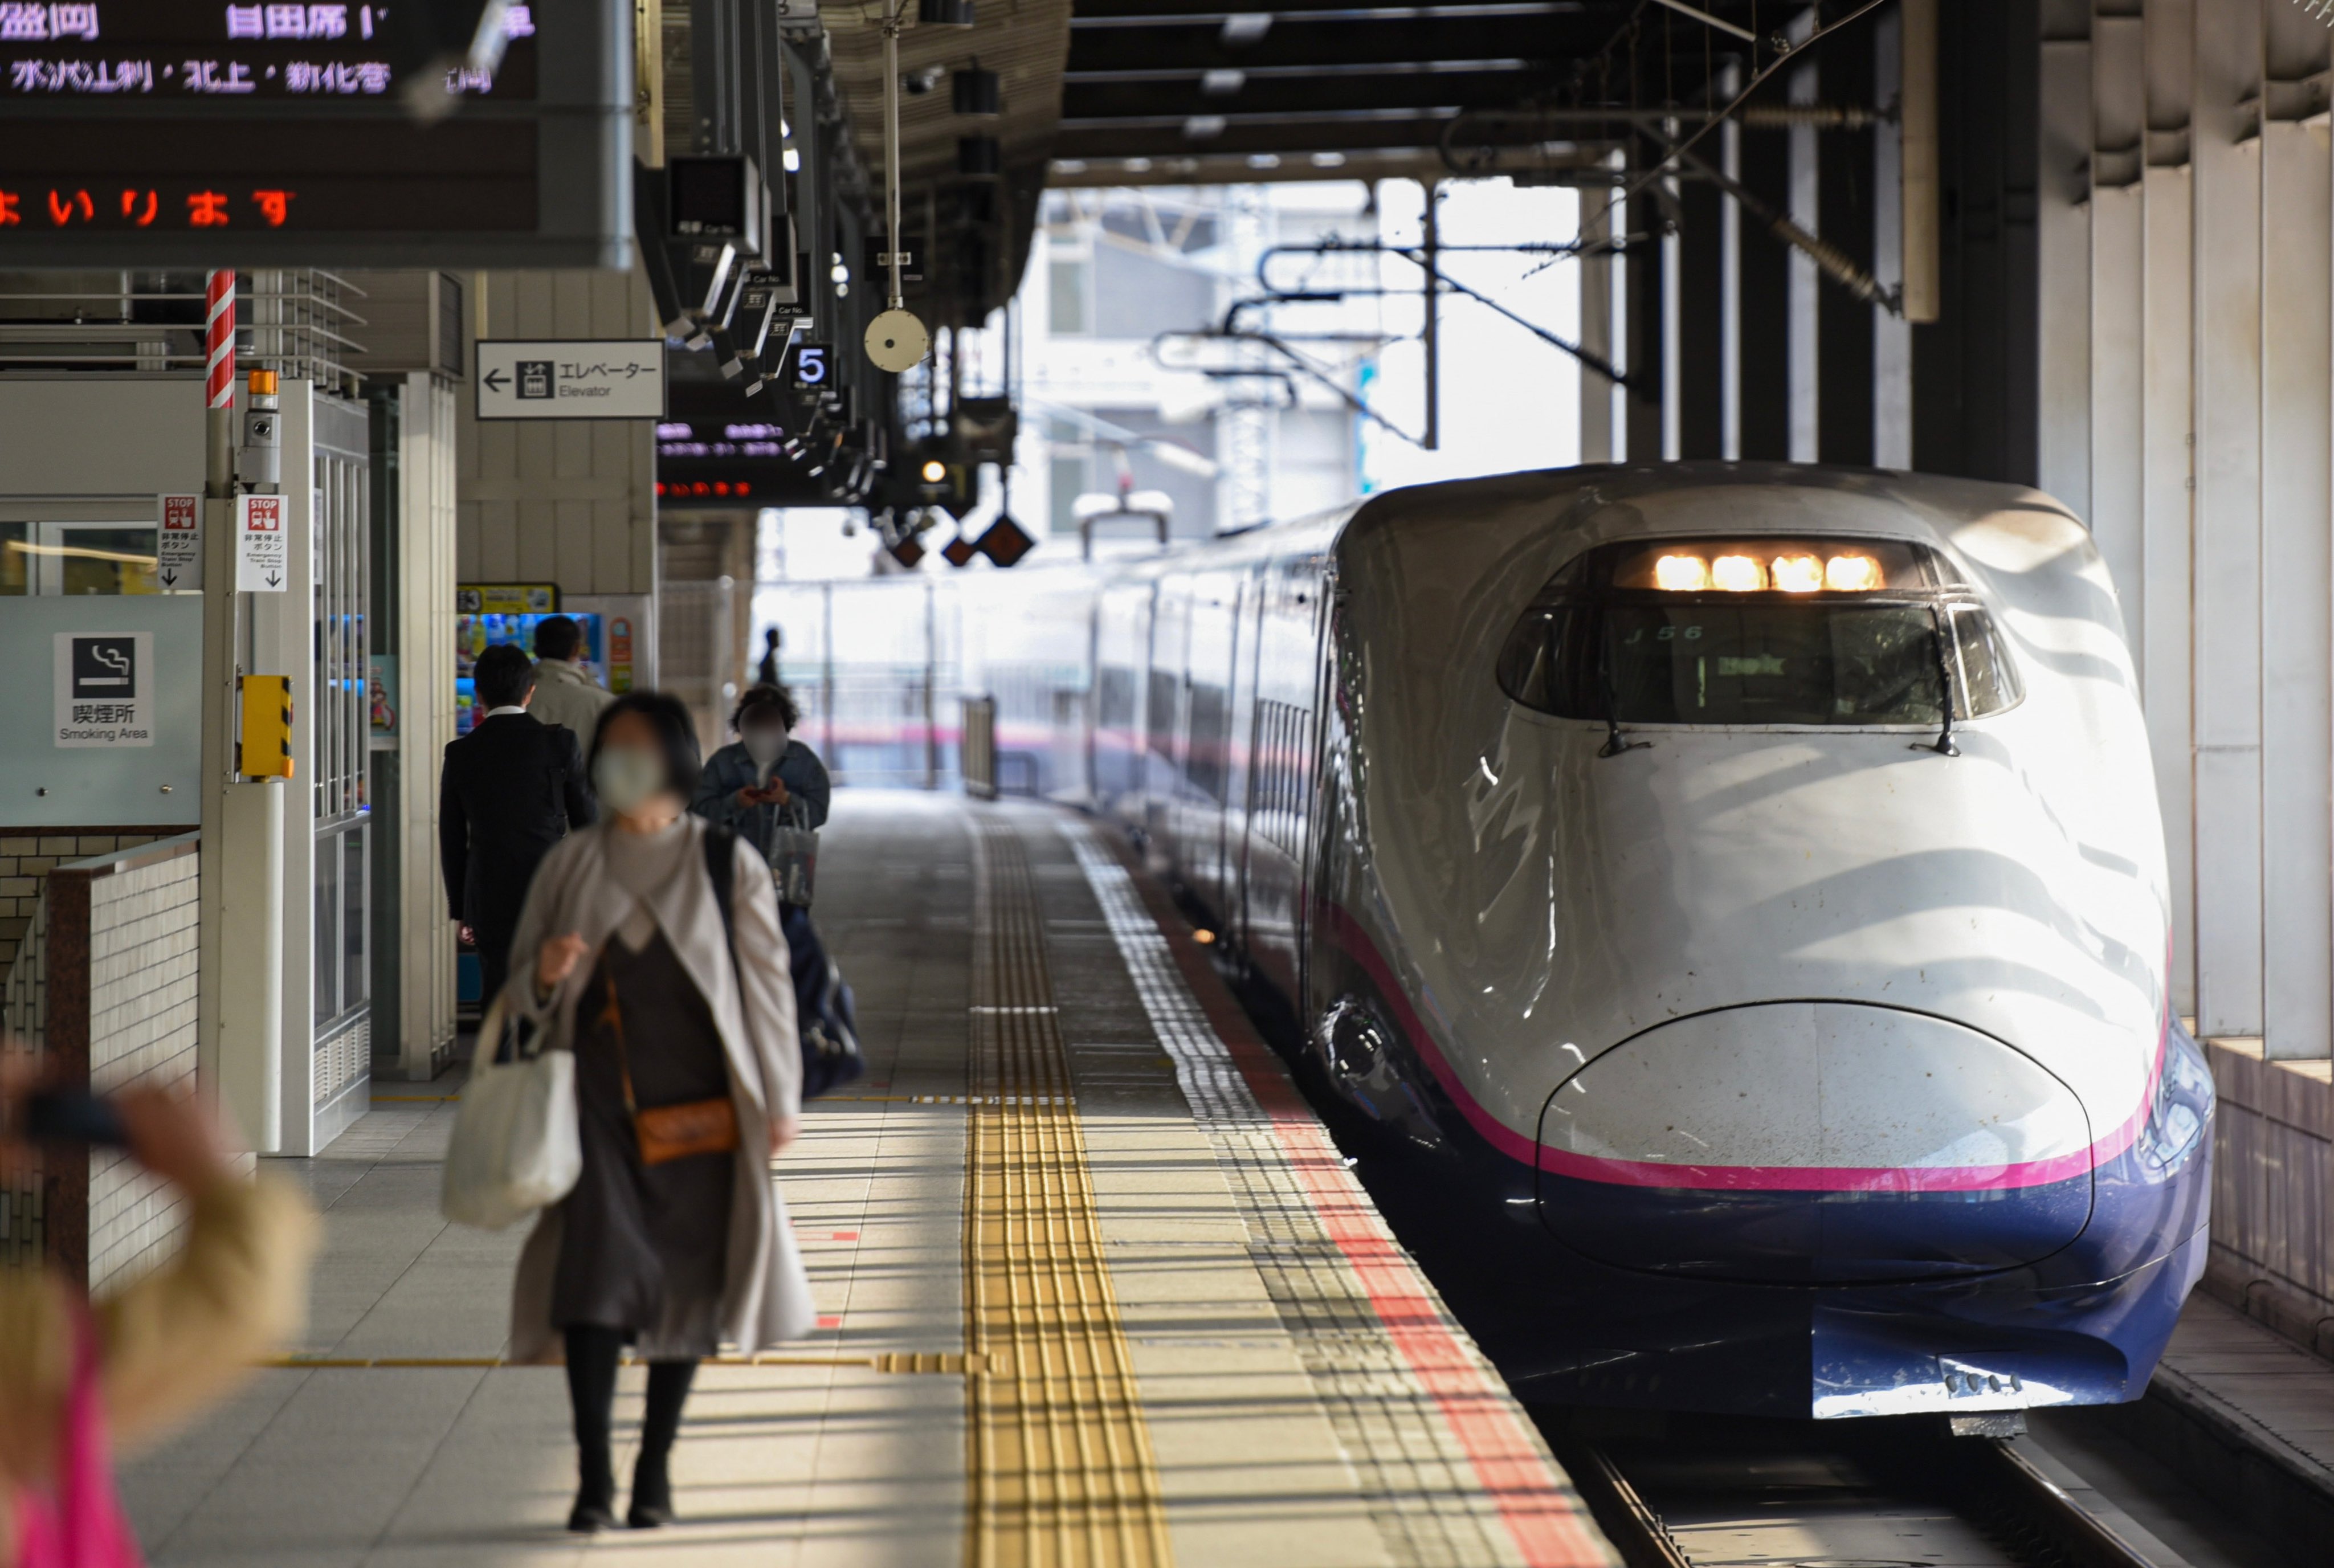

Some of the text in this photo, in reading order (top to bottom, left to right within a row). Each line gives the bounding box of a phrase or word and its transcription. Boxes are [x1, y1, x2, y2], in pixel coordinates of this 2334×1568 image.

[559, 361, 656, 379] エレベーター
[799, 349, 824, 383] 5
[559, 385, 610, 397] Elevator
[168, 499, 193, 507] STOP
[251, 500, 277, 509] STOP
[72, 704, 135, 724] 喫煙所
[60, 728, 148, 741] Smoking Area
